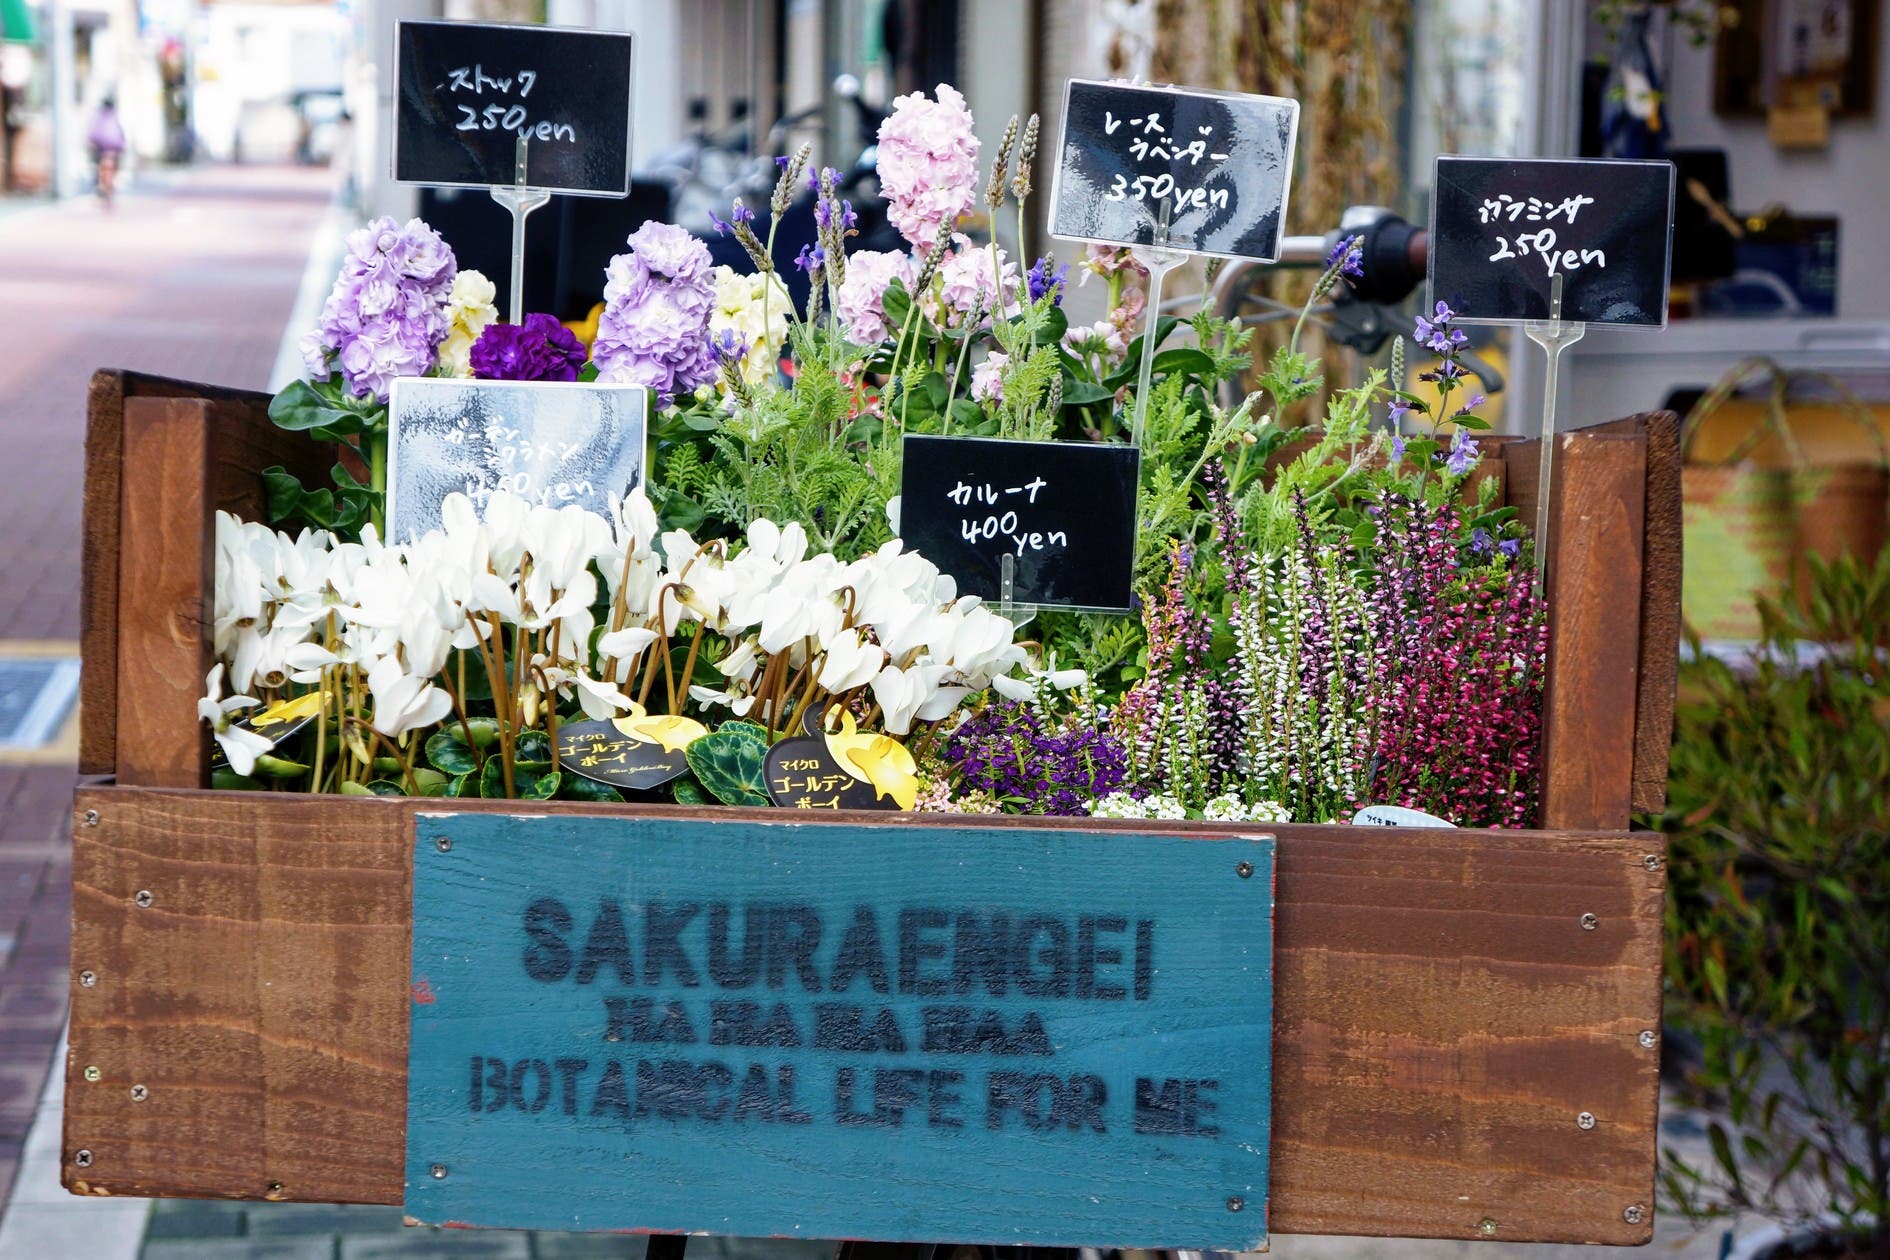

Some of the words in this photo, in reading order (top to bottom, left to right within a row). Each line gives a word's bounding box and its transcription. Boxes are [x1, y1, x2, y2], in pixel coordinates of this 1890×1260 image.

[447, 63, 537, 98] ストック
[1105, 111, 1165, 135] レース
[1129, 125, 1230, 165] ラベンダー
[946, 476, 1048, 506] カルーナ
[558, 740, 643, 757] ゴールデン
[564, 733, 606, 743] マイクロ
[580, 752, 628, 767] ボーイ
[779, 759, 820, 771] マイクロ
[773, 775, 856, 794] ゴールデン
[522, 897, 1154, 1001] SAKURAENGEI
[833, 1066, 966, 1130] LIFE
[984, 1071, 1108, 1134] FOR
[1133, 1076, 1219, 1140] ME
